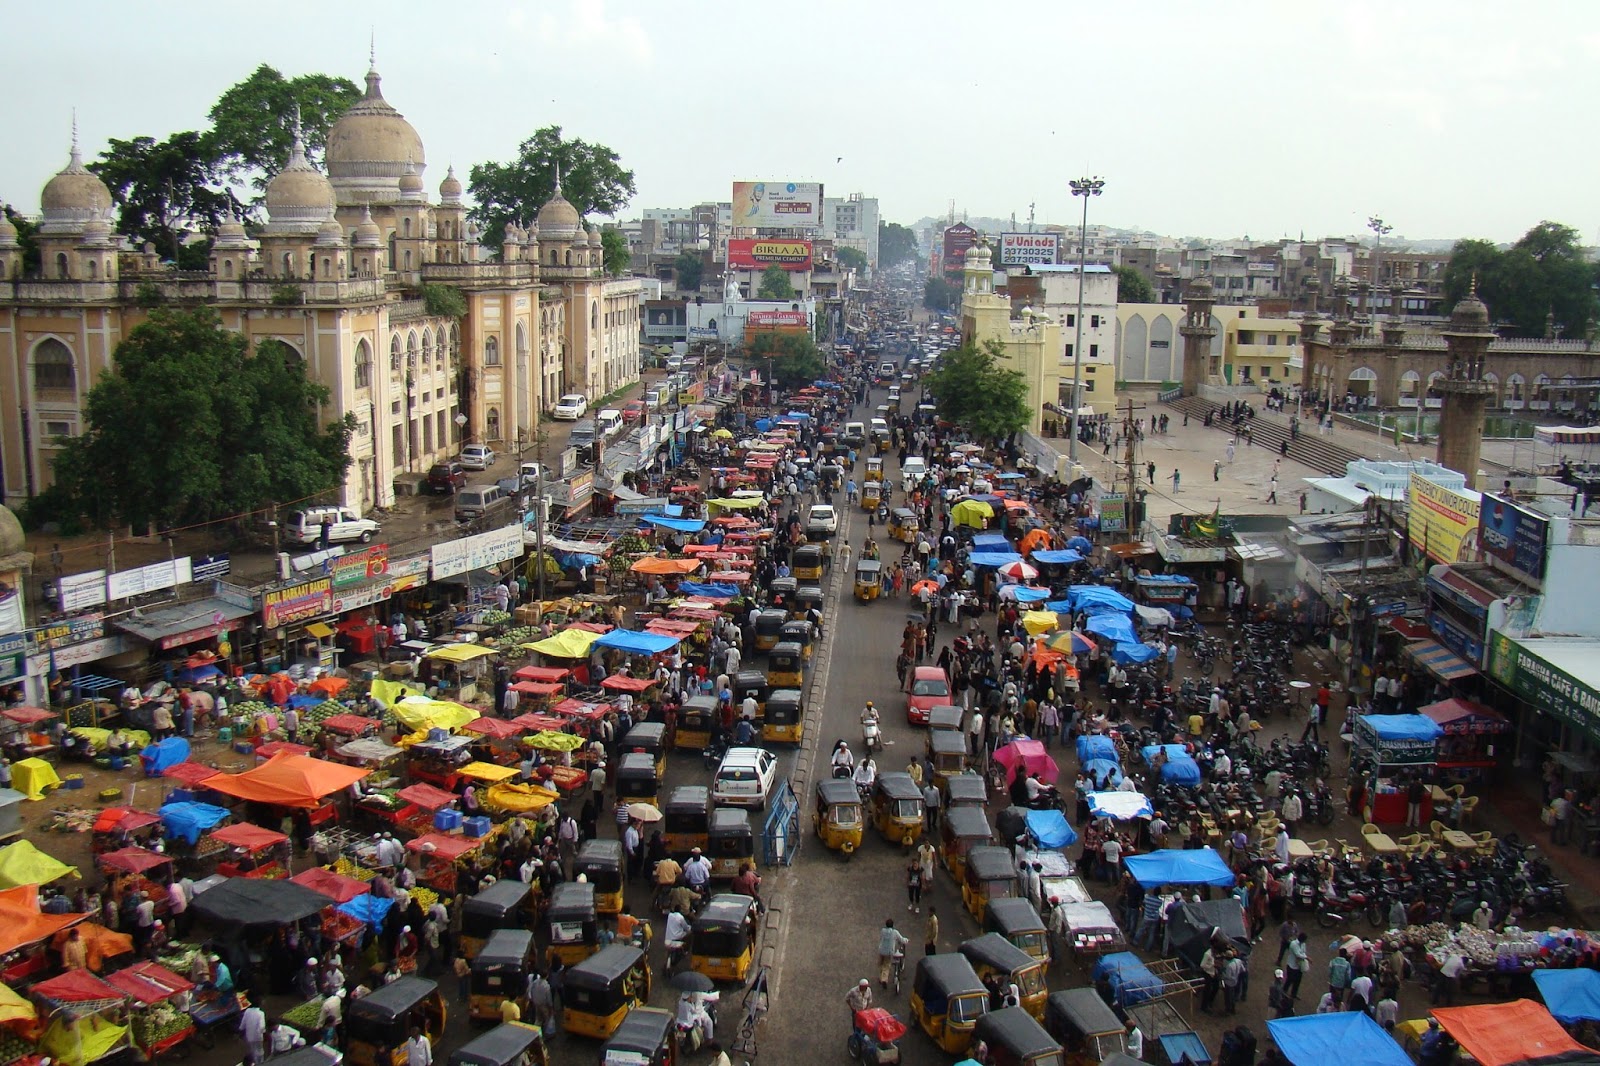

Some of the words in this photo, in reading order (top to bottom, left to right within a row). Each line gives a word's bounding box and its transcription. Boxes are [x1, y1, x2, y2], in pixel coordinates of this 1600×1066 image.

[756, 246, 791, 254] BIRLA
[1016, 237, 1033, 246] Uni
[1035, 237, 1054, 247] ads
[1439, 490, 1458, 507] JUNIOR
[1484, 526, 1508, 549] PEPSI
[337, 551, 368, 567] ROSHAN
[309, 578, 331, 594] BAKERY
[1551, 674, 1572, 698] CAFE
[1572, 687, 1580, 702] &
